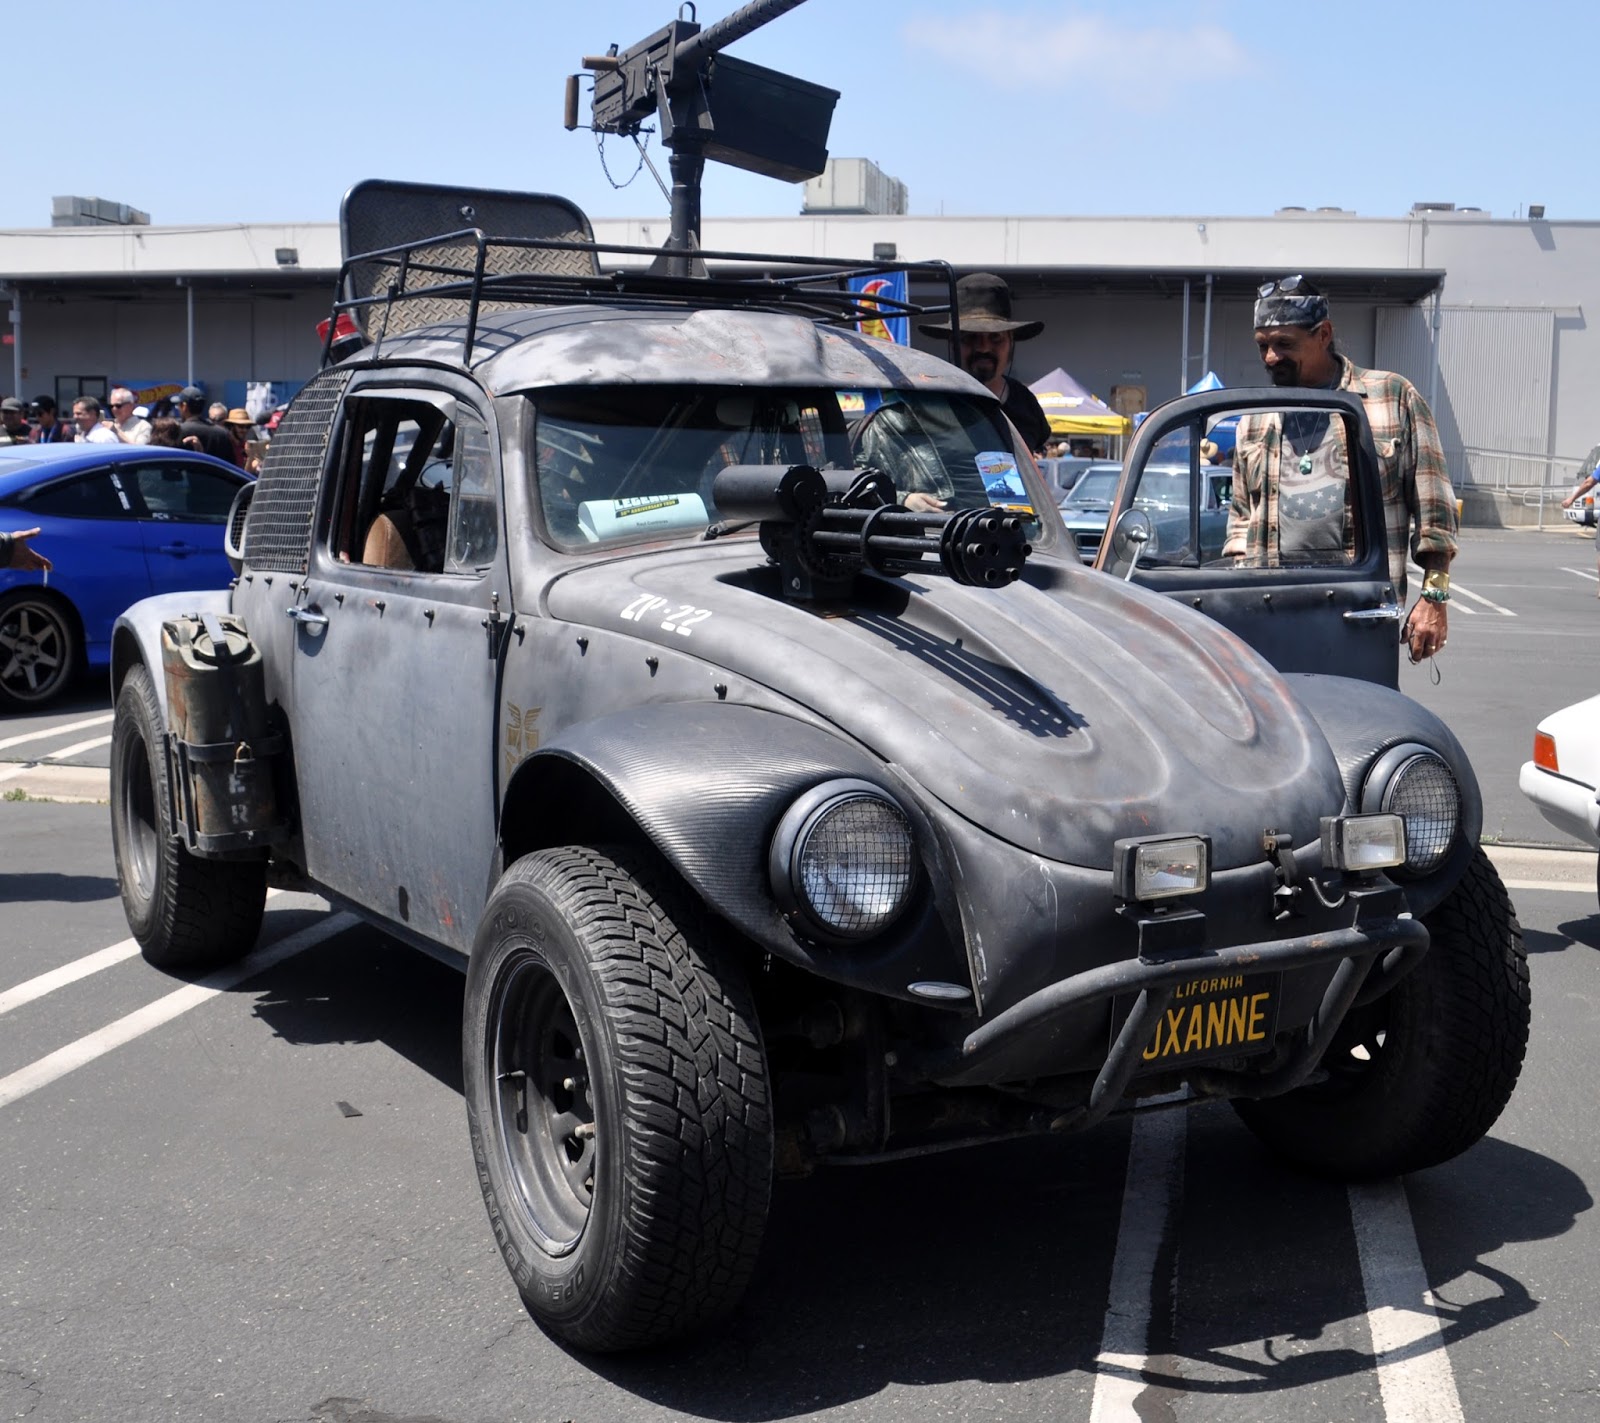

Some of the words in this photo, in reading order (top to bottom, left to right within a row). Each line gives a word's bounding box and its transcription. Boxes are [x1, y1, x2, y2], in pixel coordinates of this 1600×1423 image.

[614, 495, 678, 510] LEGEN
[493, 904, 546, 942] TOYO
[1175, 975, 1244, 999] LIFORNIA
[1142, 992, 1270, 1060] XANNE
[538, 1260, 585, 1306] OPEN
